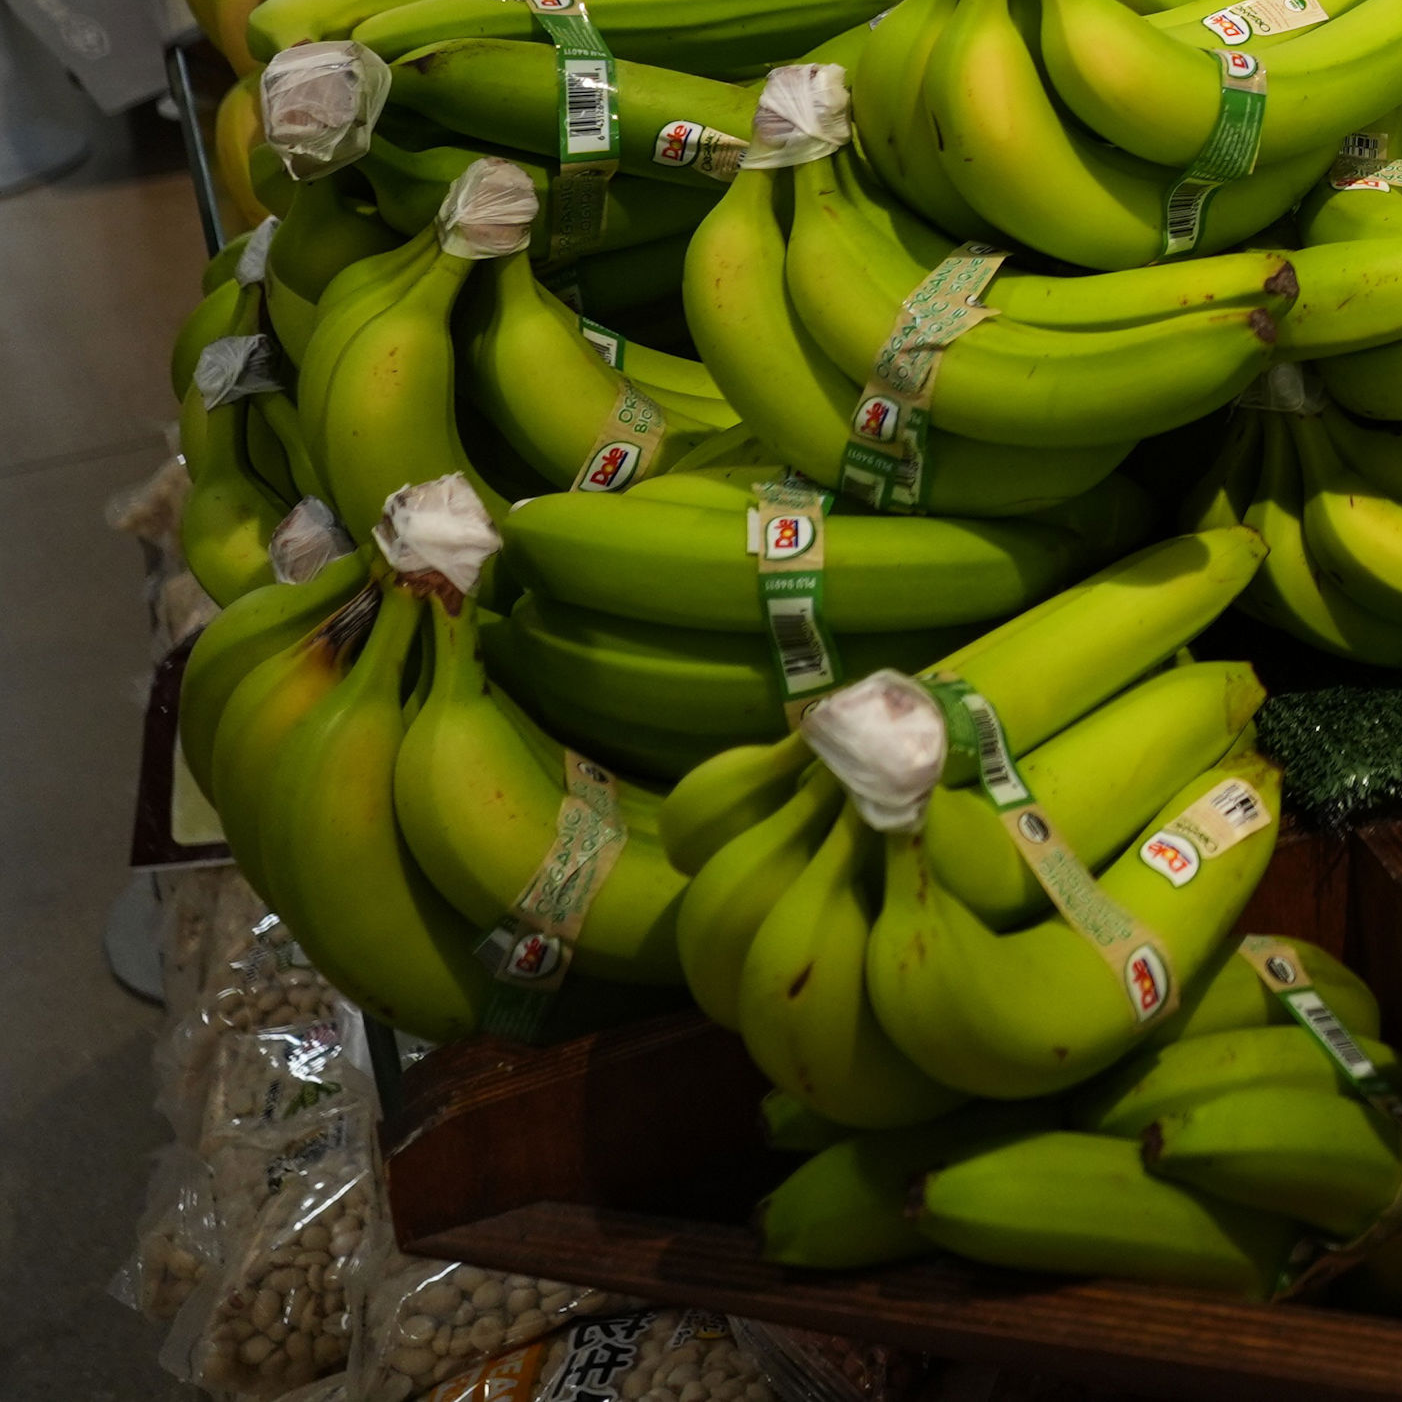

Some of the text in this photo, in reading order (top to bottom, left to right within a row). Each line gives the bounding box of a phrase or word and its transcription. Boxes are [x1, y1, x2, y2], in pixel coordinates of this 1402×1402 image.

[1210, 14, 1241, 39] Dole
[661, 124, 689, 161] Dole
[861, 401, 885, 436] Dole
[590, 447, 626, 486] Dole
[774, 519, 796, 549] Dole
[1147, 841, 1188, 873] Dole
[515, 938, 543, 974] Dole
[1132, 957, 1160, 1010] Dole
